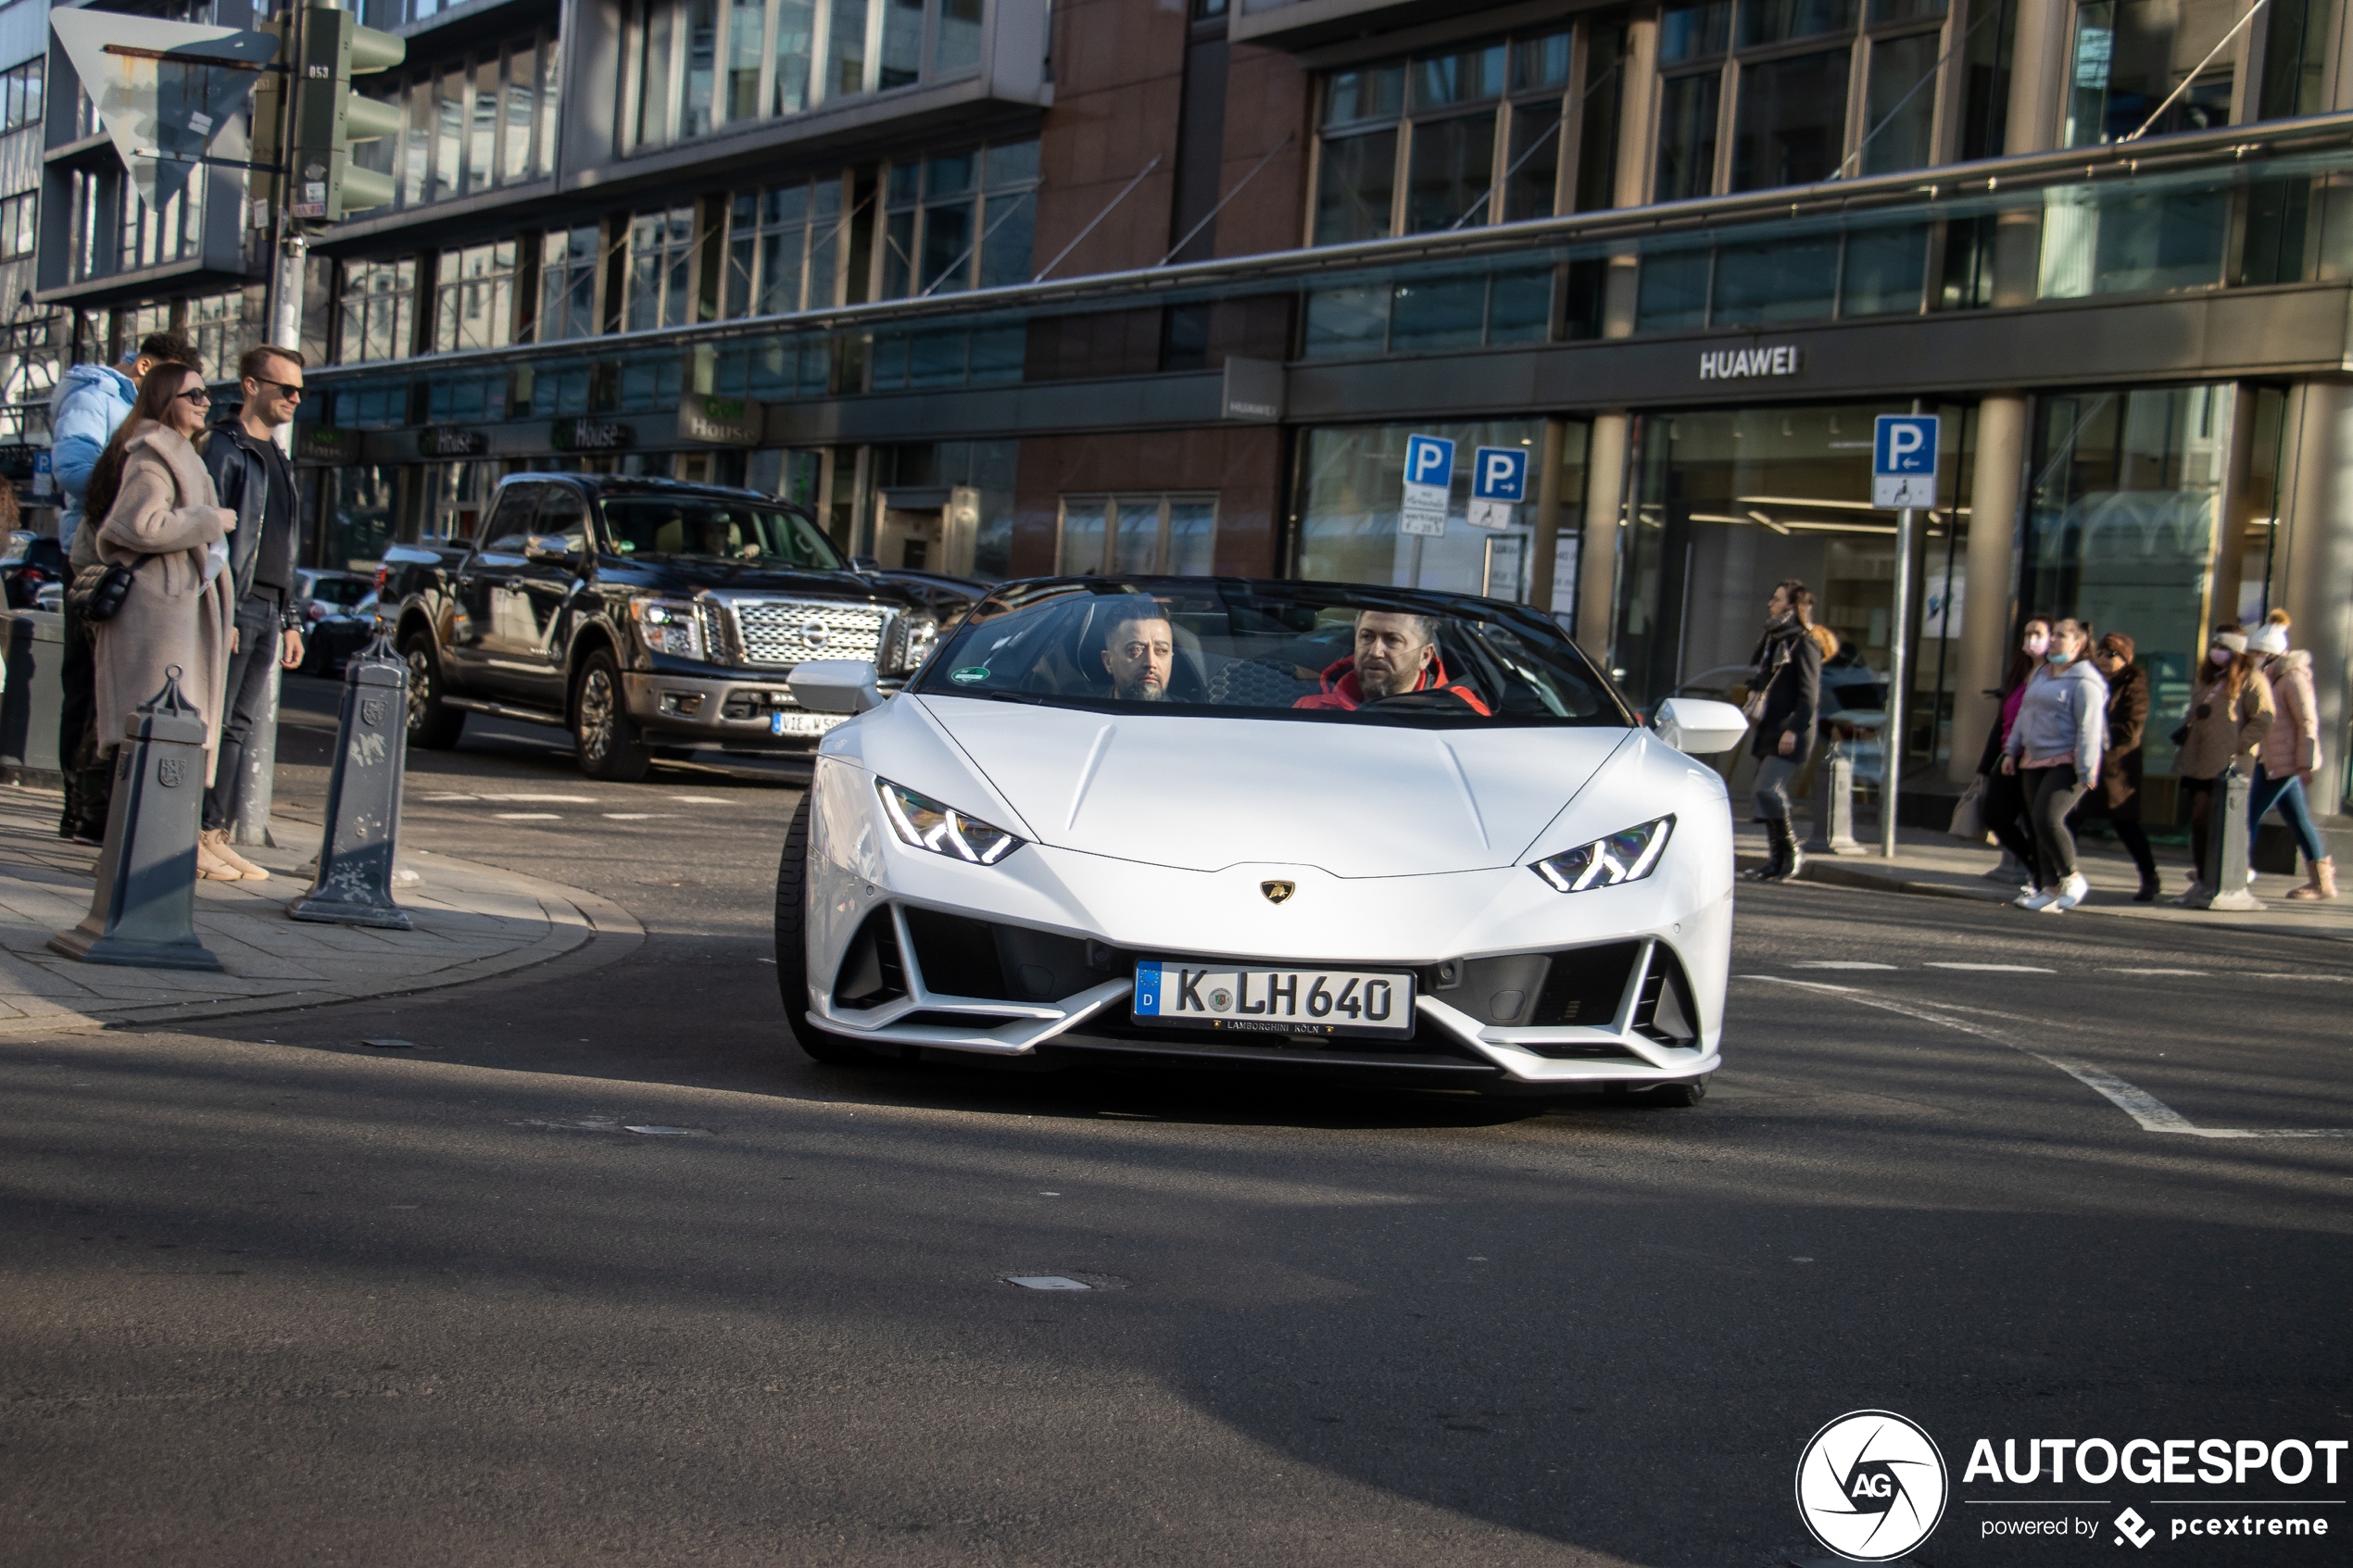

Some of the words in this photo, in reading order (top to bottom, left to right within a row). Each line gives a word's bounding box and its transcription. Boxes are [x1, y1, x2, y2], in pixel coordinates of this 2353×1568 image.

[308, 65, 329, 80] 053
[1699, 345, 1797, 381] HUAWEI
[690, 417, 755, 440] House
[1888, 423, 1924, 470] P
[1415, 443, 1443, 482] P
[1485, 454, 1516, 494] P
[783, 717, 804, 731] VIE
[1143, 994, 1154, 1006] D
[1176, 969, 1208, 1011] K
[1227, 1021, 1290, 1033] LAMBORGHINI
[1294, 1022, 1319, 1034] KÖLN
